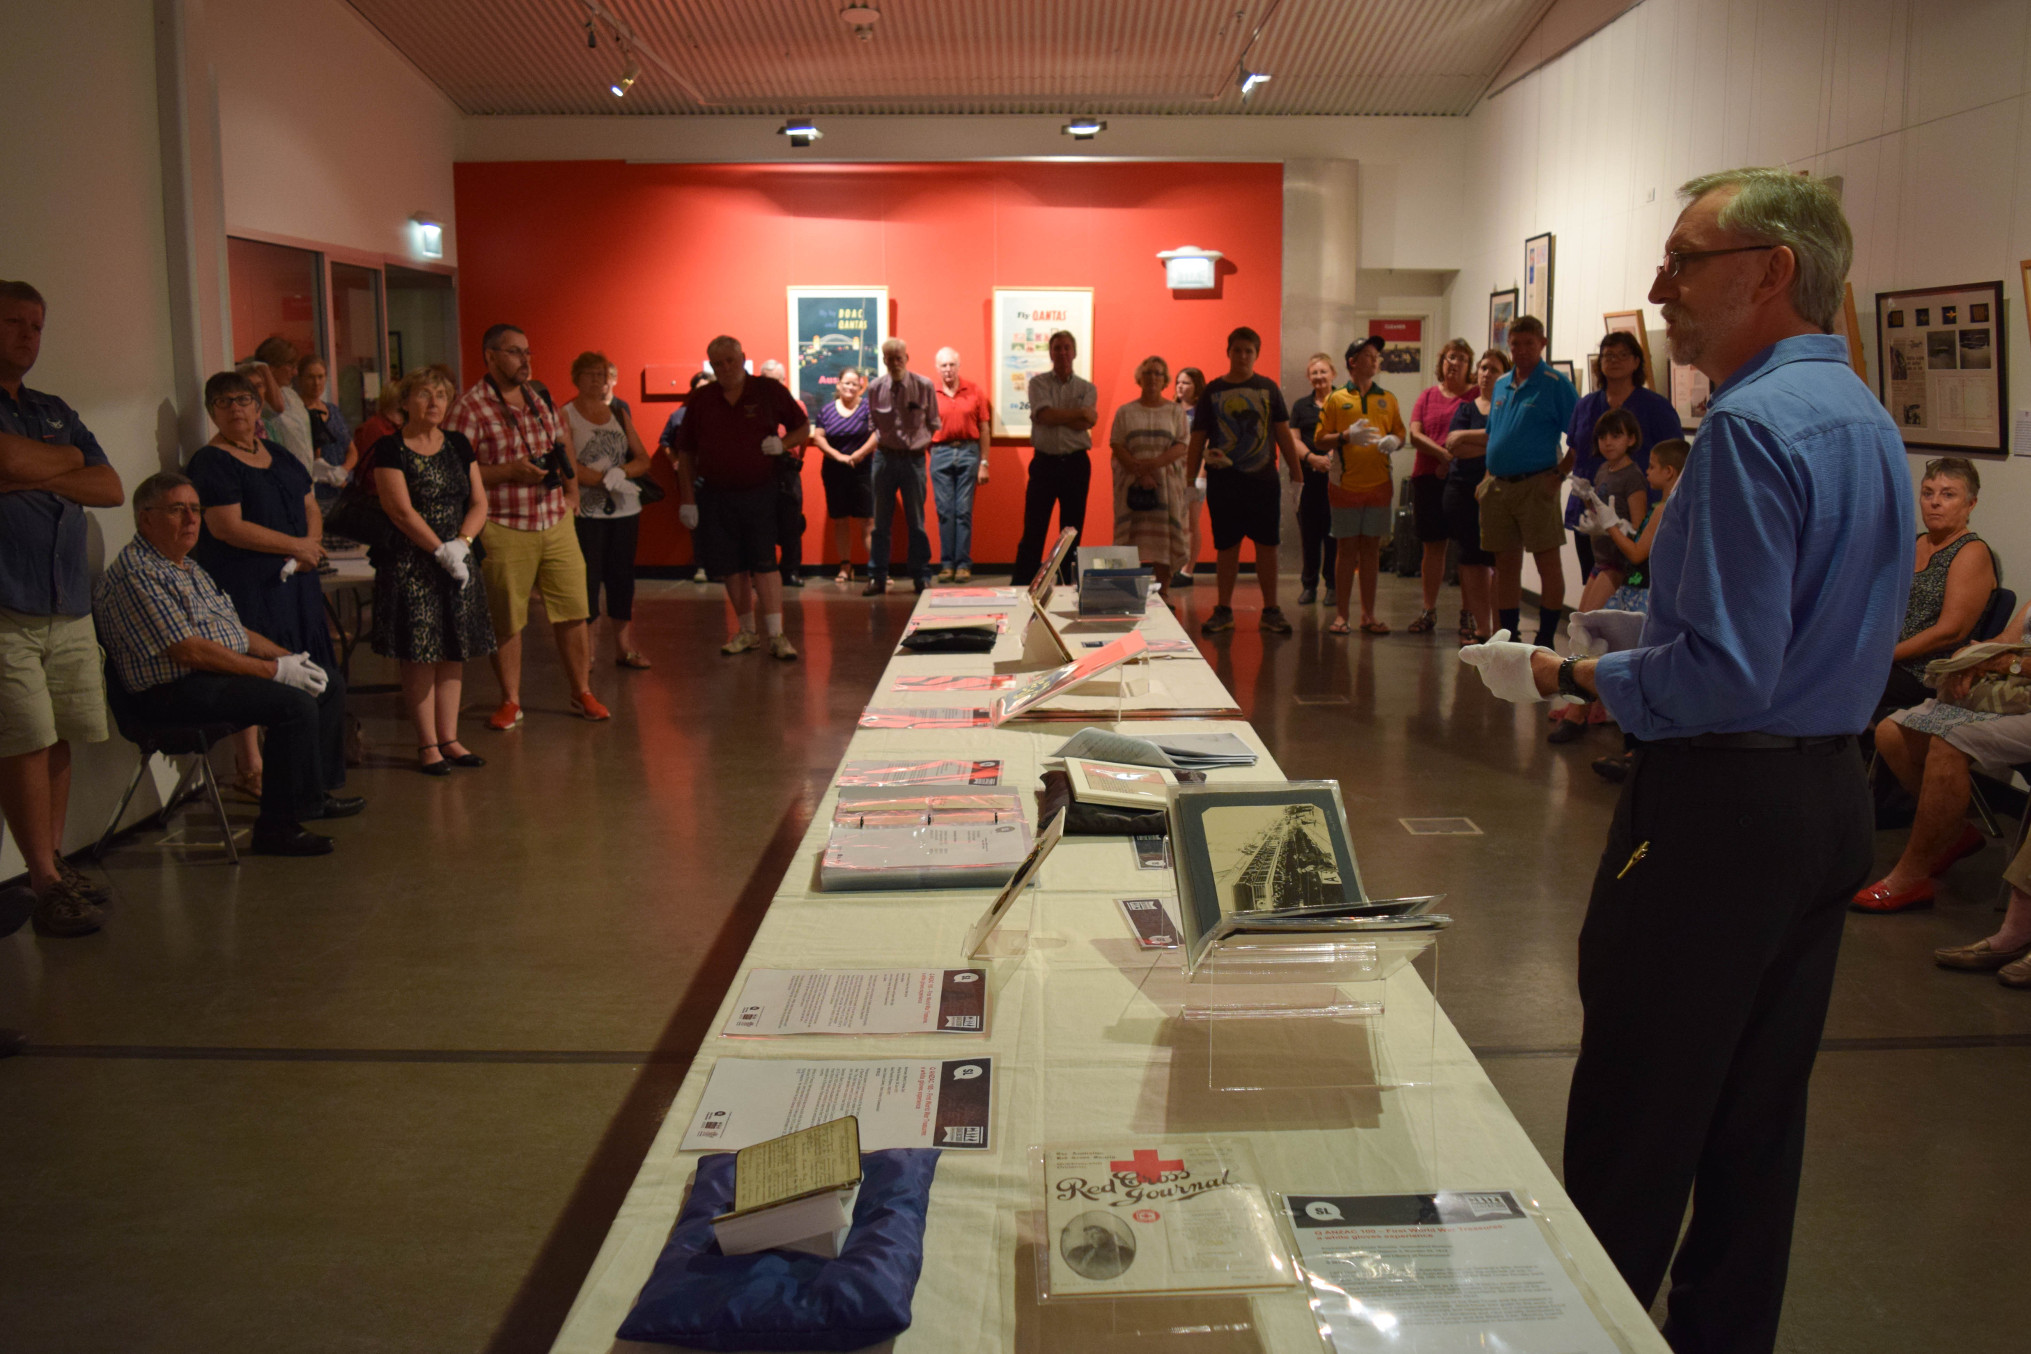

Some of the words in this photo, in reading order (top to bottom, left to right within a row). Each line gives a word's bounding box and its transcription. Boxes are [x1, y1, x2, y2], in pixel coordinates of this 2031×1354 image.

[838, 308, 863, 319] BOAC
[1017, 311, 1030, 320] Fly
[1032, 309, 1067, 321] QANTAS
[838, 319, 868, 330] QANTAS
[963, 1068, 974, 1076] SL
[1056, 1177, 1117, 1200] Red
[1112, 1170, 1191, 1188] Cross
[1109, 1169, 1236, 1207] Journal
[1315, 1207, 1332, 1215] SL
[1458, 1224, 1503, 1232] Treasures
